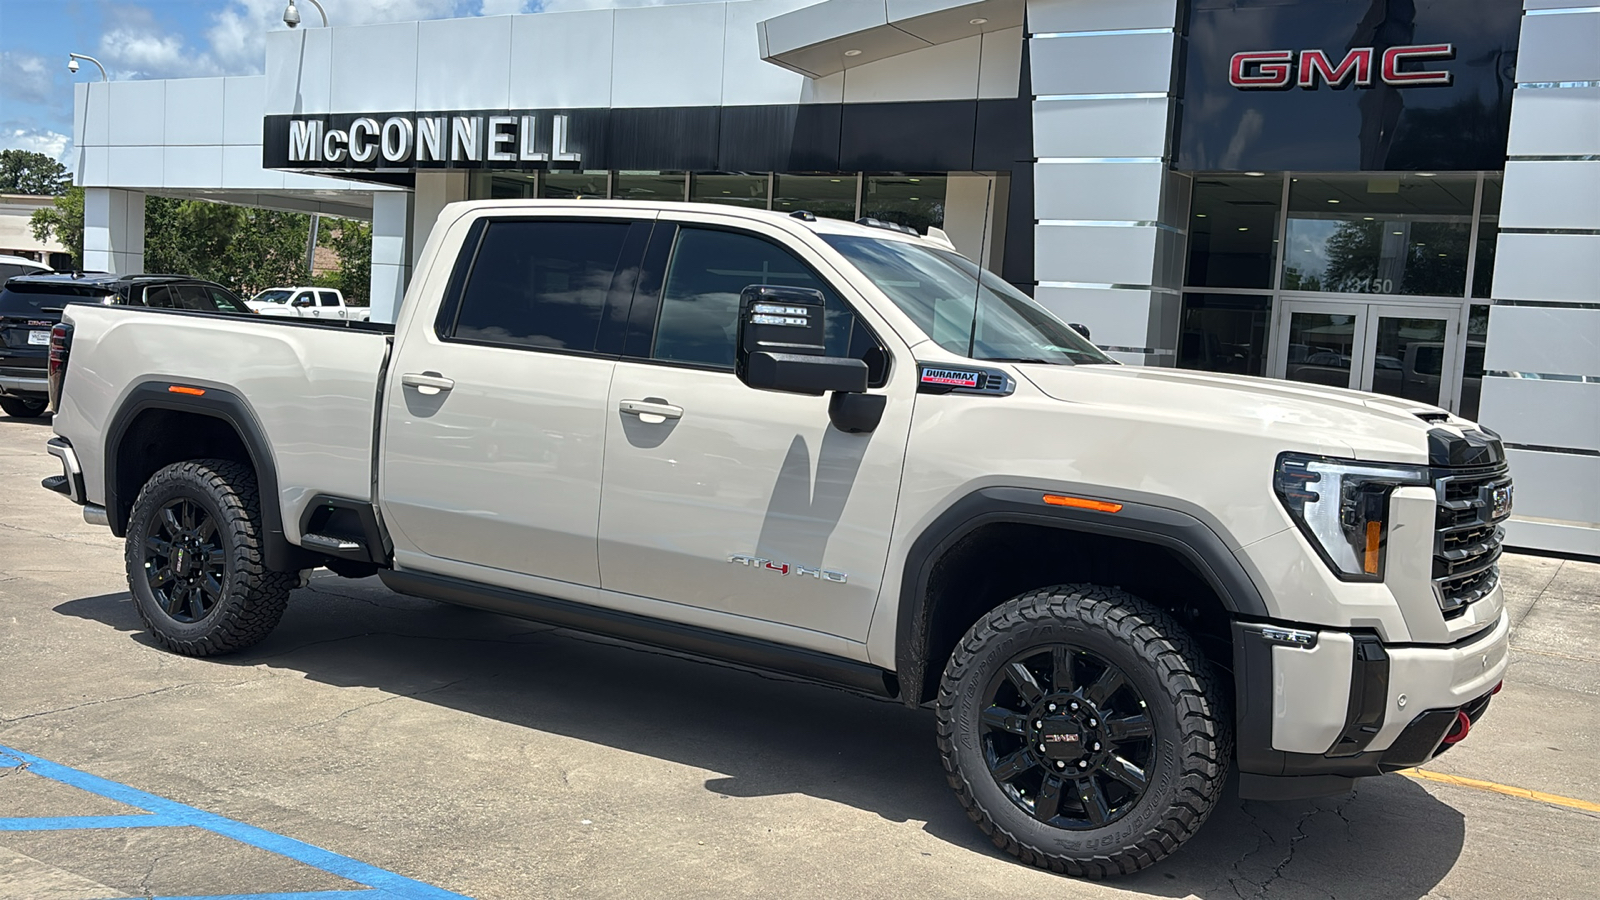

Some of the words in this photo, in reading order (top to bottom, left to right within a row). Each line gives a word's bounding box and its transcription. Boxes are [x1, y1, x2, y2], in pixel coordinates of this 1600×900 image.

[1229, 43, 1452, 88] GMC
[288, 115, 581, 162] McCONNELL
[1351, 277, 1393, 293] 3150
[926, 369, 975, 381] DURAMAX
[726, 554, 789, 576] AT4
[797, 565, 847, 583] HD
